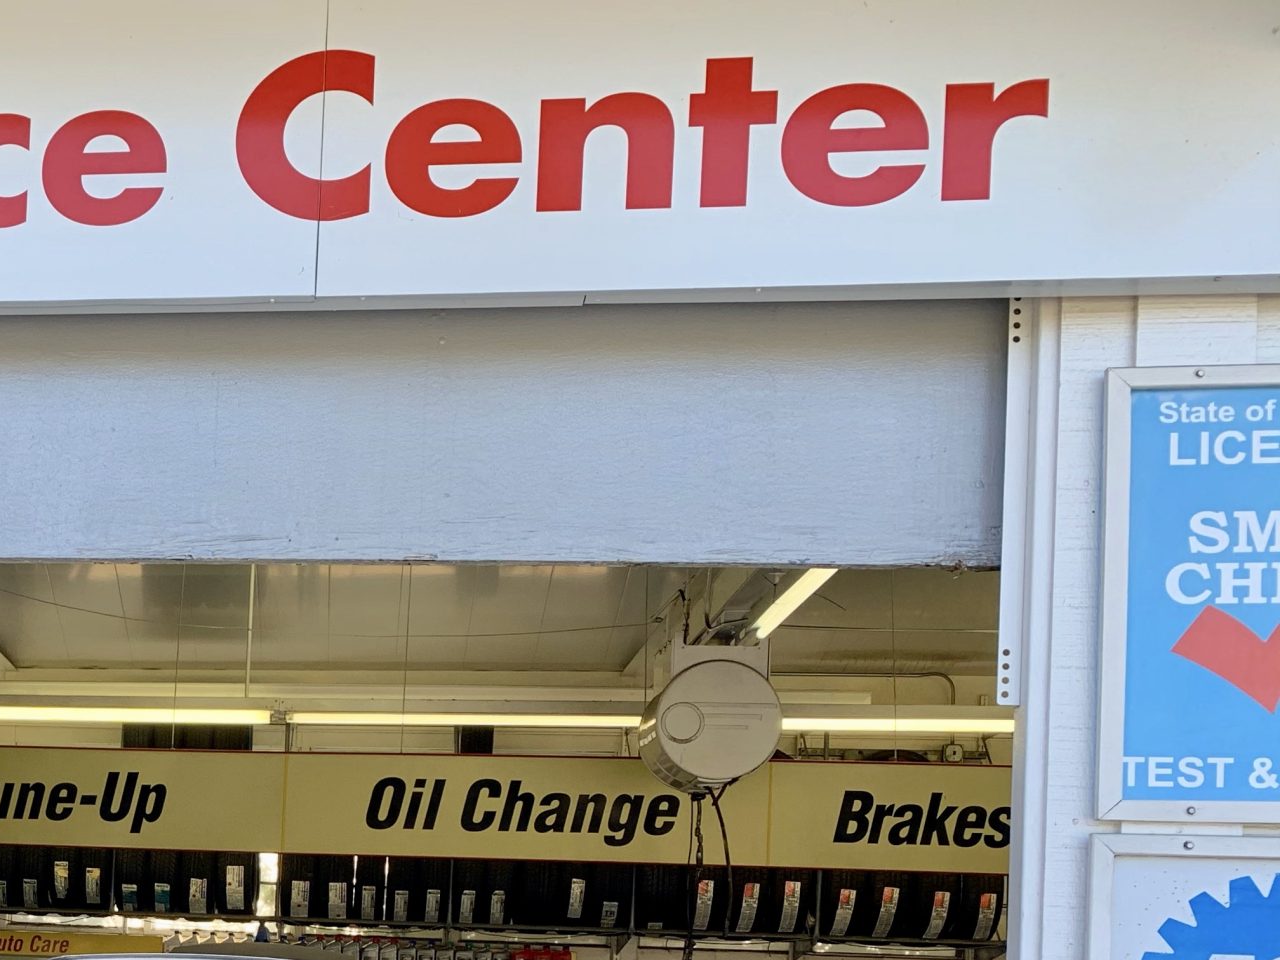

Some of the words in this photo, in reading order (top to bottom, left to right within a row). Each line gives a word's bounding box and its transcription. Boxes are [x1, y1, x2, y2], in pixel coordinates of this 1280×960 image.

[235, 49, 1050, 221] Center
[1159, 401, 1236, 424] State
[1245, 399, 1277, 421] of
[1169, 430, 1280, 466] LICE
[1165, 562, 1280, 605] CH
[1122, 756, 1235, 788] TEST
[1248, 757, 1280, 789] &
[365, 776, 446, 832] Oil
[461, 779, 680, 846] Change
[833, 790, 1011, 848] Brakes
[30, 935, 69, 953] Care
